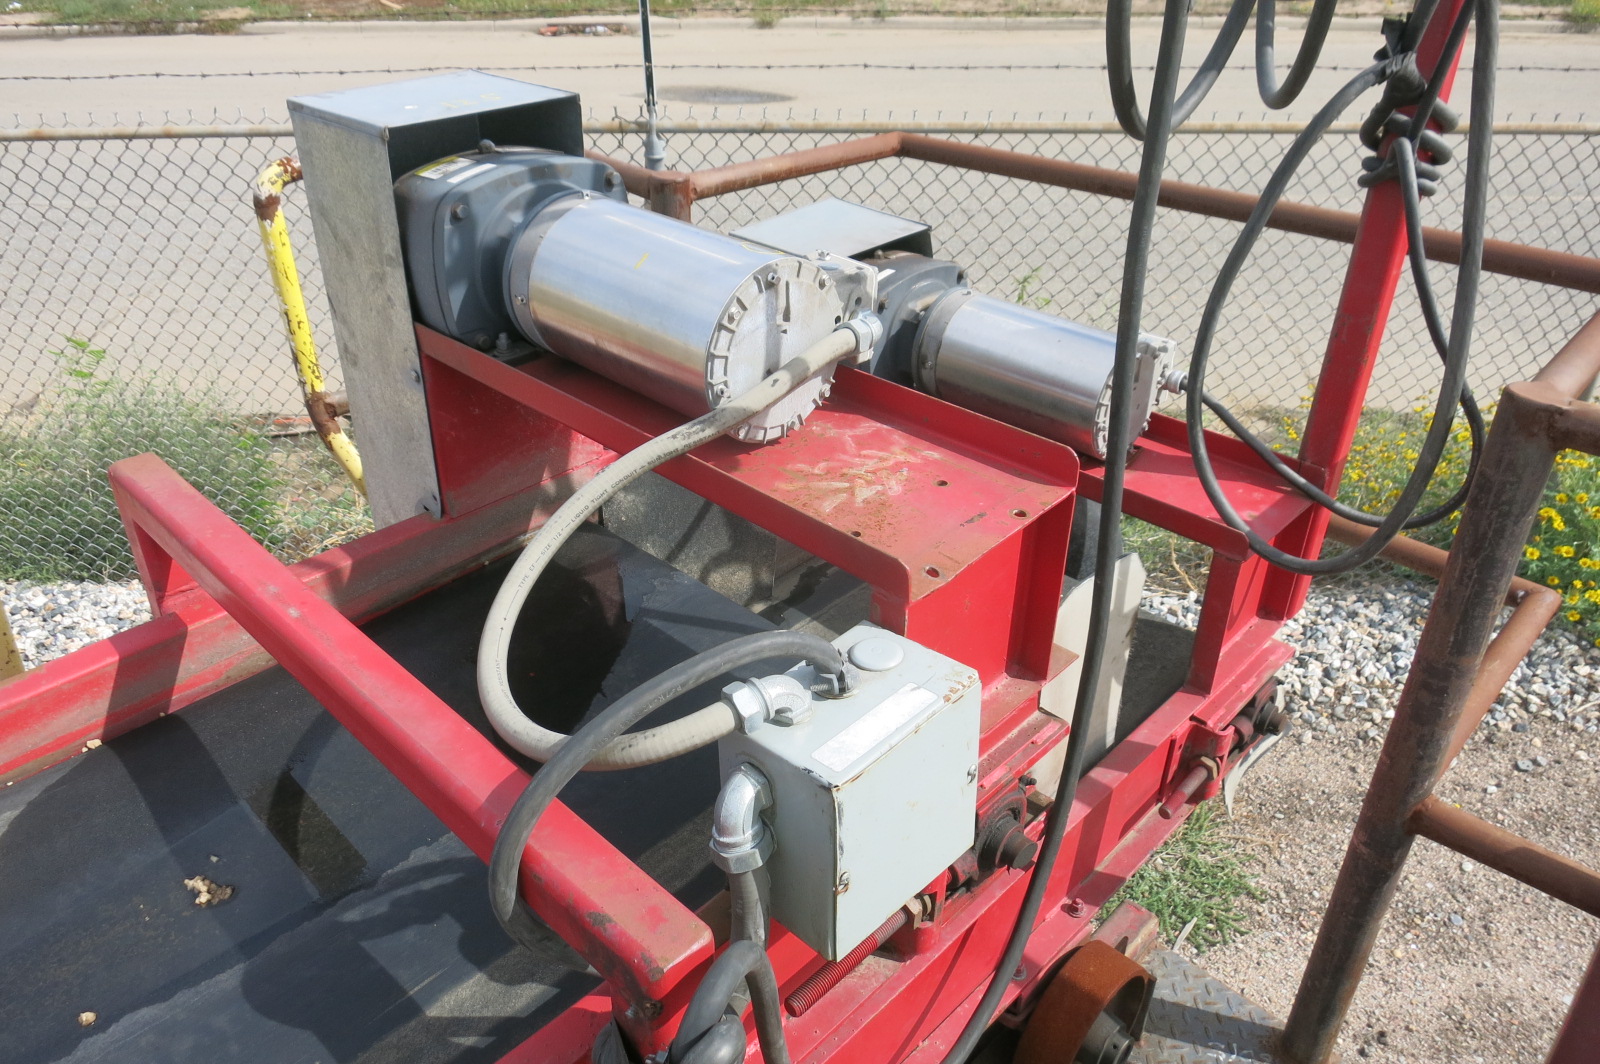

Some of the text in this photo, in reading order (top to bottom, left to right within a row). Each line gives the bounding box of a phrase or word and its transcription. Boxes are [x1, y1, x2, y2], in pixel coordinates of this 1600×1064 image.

[571, 505, 589, 522] LIQUID
[591, 489, 608, 504] TIGHT
[611, 469, 638, 488] CONDUIT
[647, 448, 679, 465] SUNLIGHT
[683, 431, 720, 449] RESISTANT
